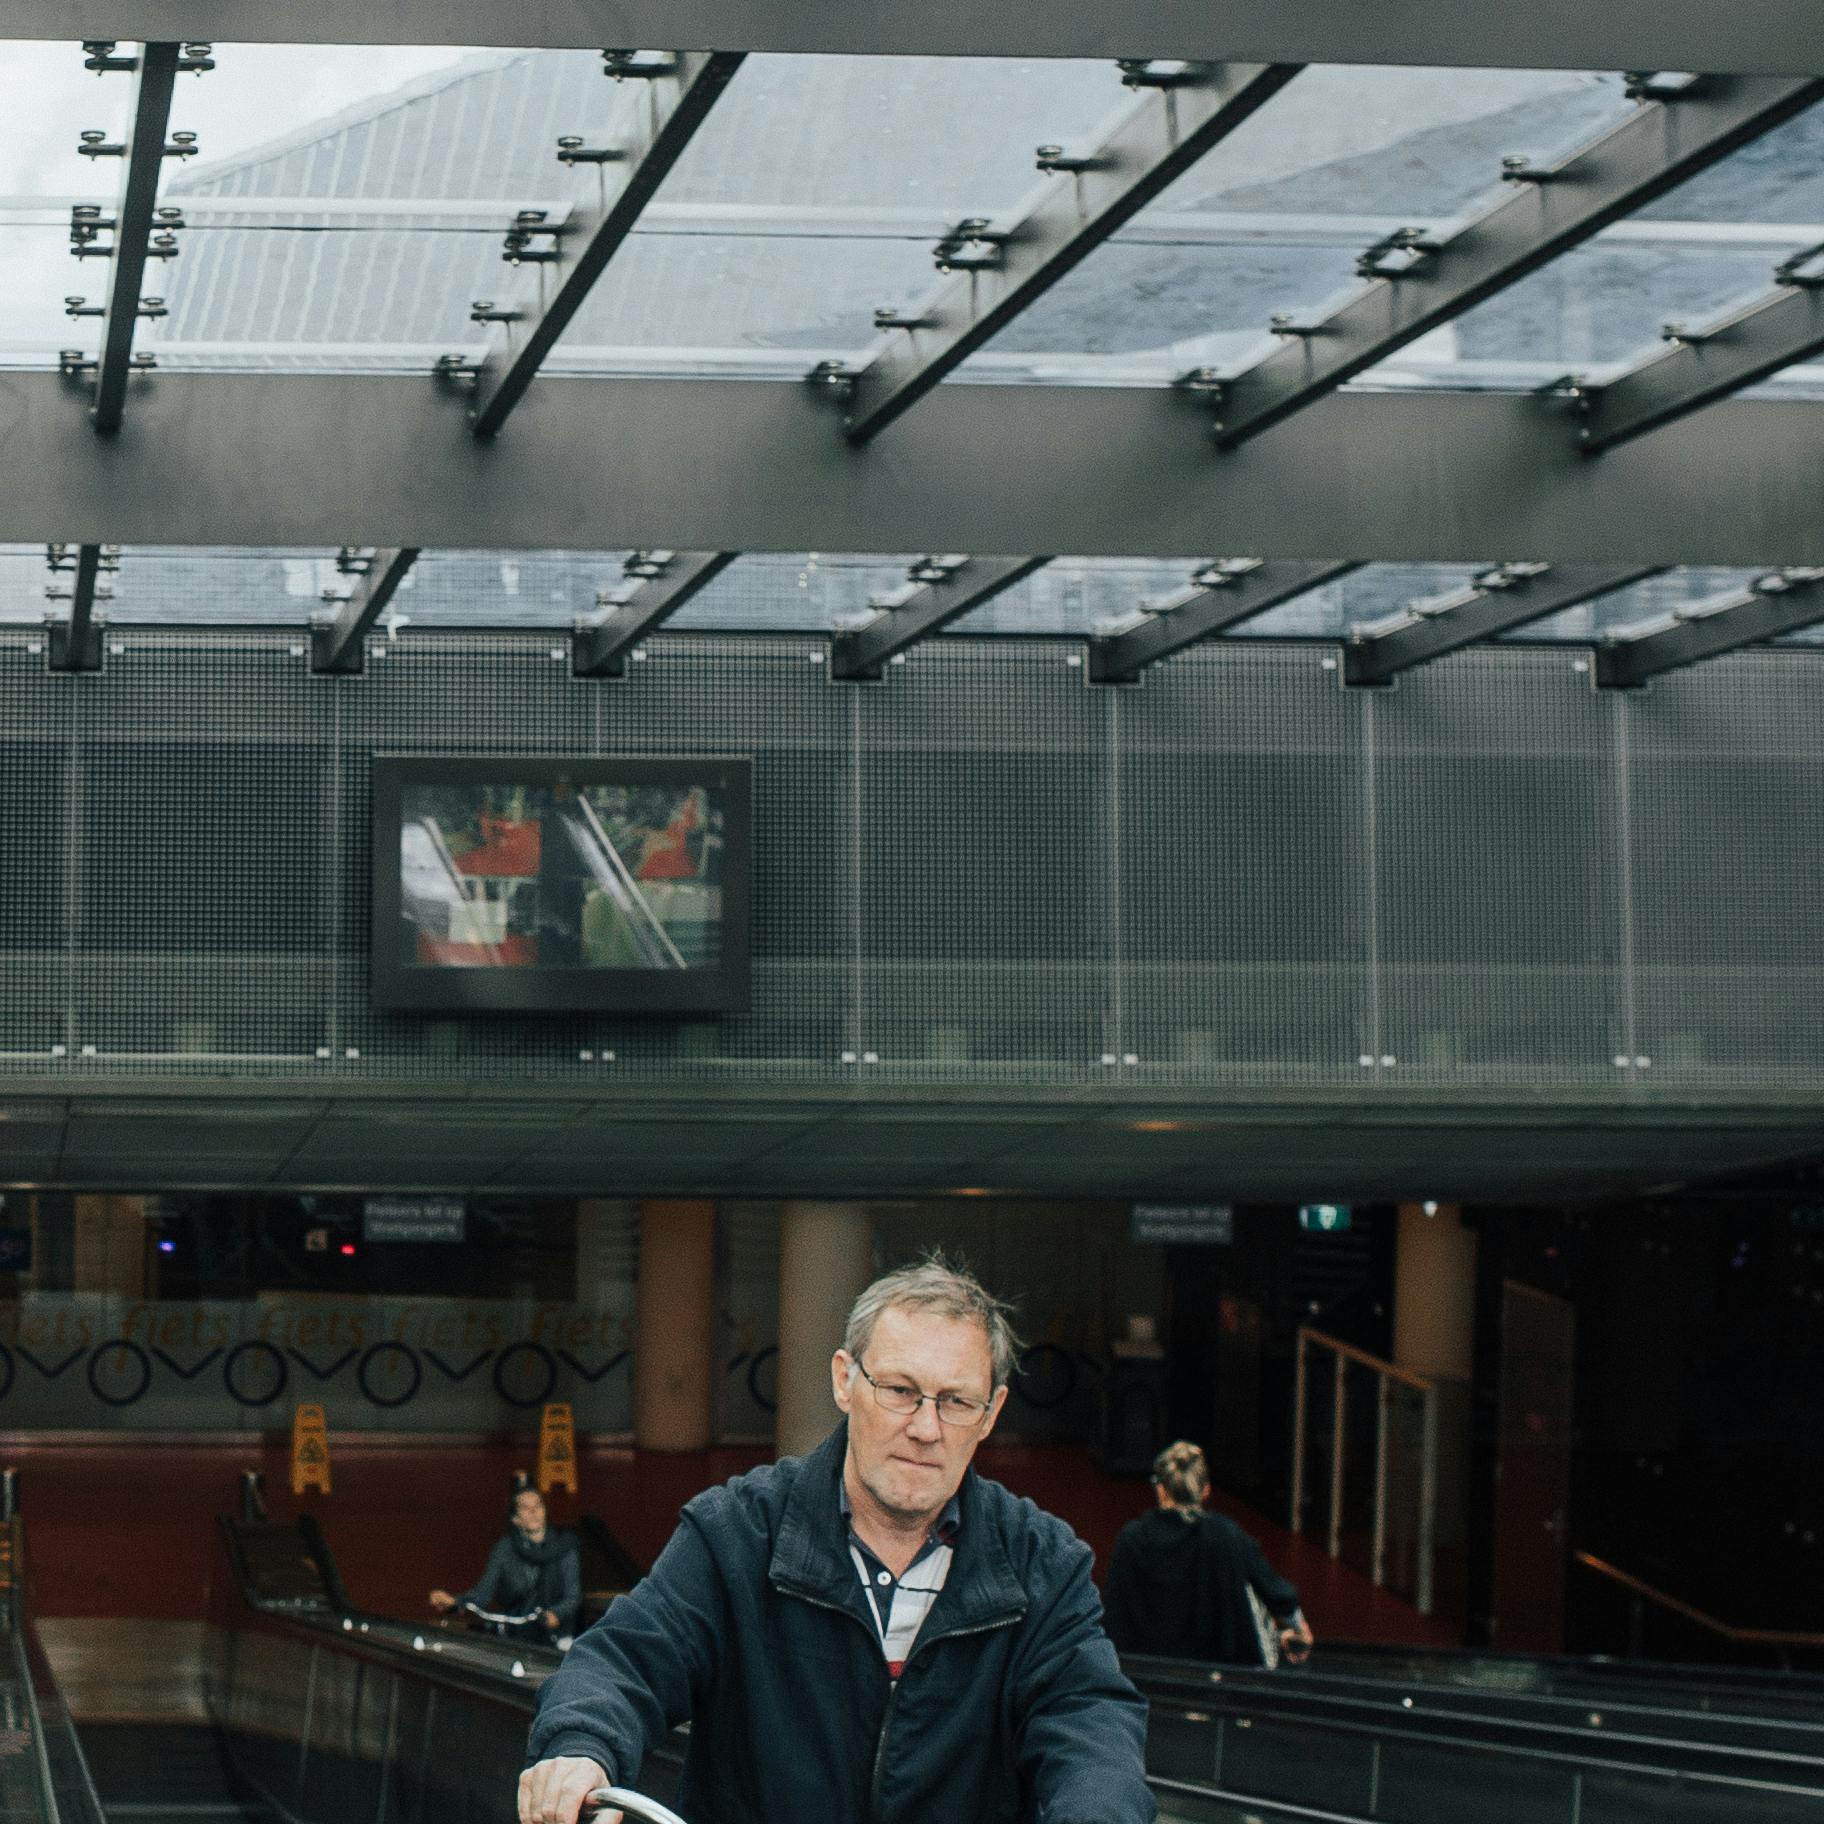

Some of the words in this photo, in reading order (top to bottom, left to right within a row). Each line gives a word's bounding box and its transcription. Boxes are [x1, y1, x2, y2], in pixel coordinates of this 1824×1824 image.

[115, 1302, 227, 1372] fiets
[253, 1300, 368, 1371] fiets
[389, 1302, 504, 1373] fiets
